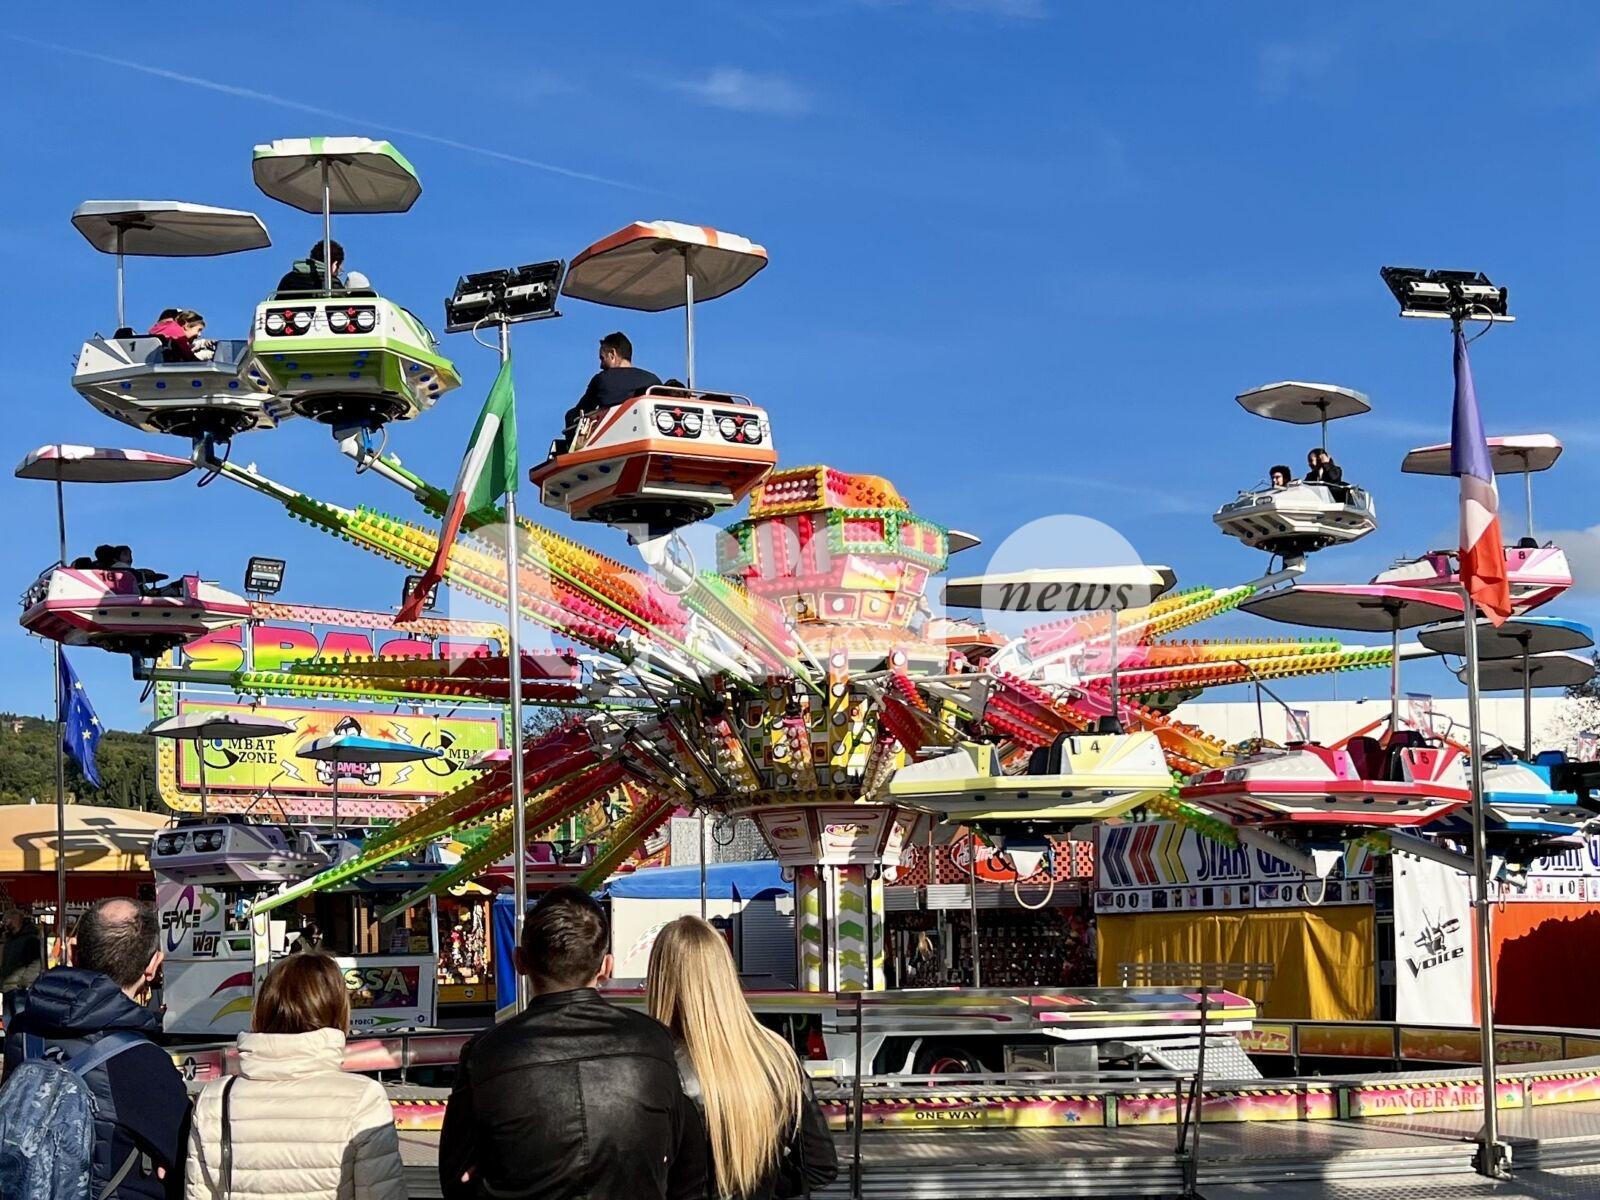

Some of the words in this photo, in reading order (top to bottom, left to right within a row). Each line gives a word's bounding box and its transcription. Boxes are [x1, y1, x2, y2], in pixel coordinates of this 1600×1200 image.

[129, 341, 137, 352] 1
[1518, 551, 1526, 560] 8
[1090, 740, 1101, 753] 4
[239, 752, 278, 764] ZONE
[1405, 947, 1464, 979] Voice
[1375, 1090, 1445, 1108] DANGER
[1451, 1091, 1484, 1106] ARE
[915, 1111, 944, 1120] ONE
[948, 1111, 980, 1120] WAY
